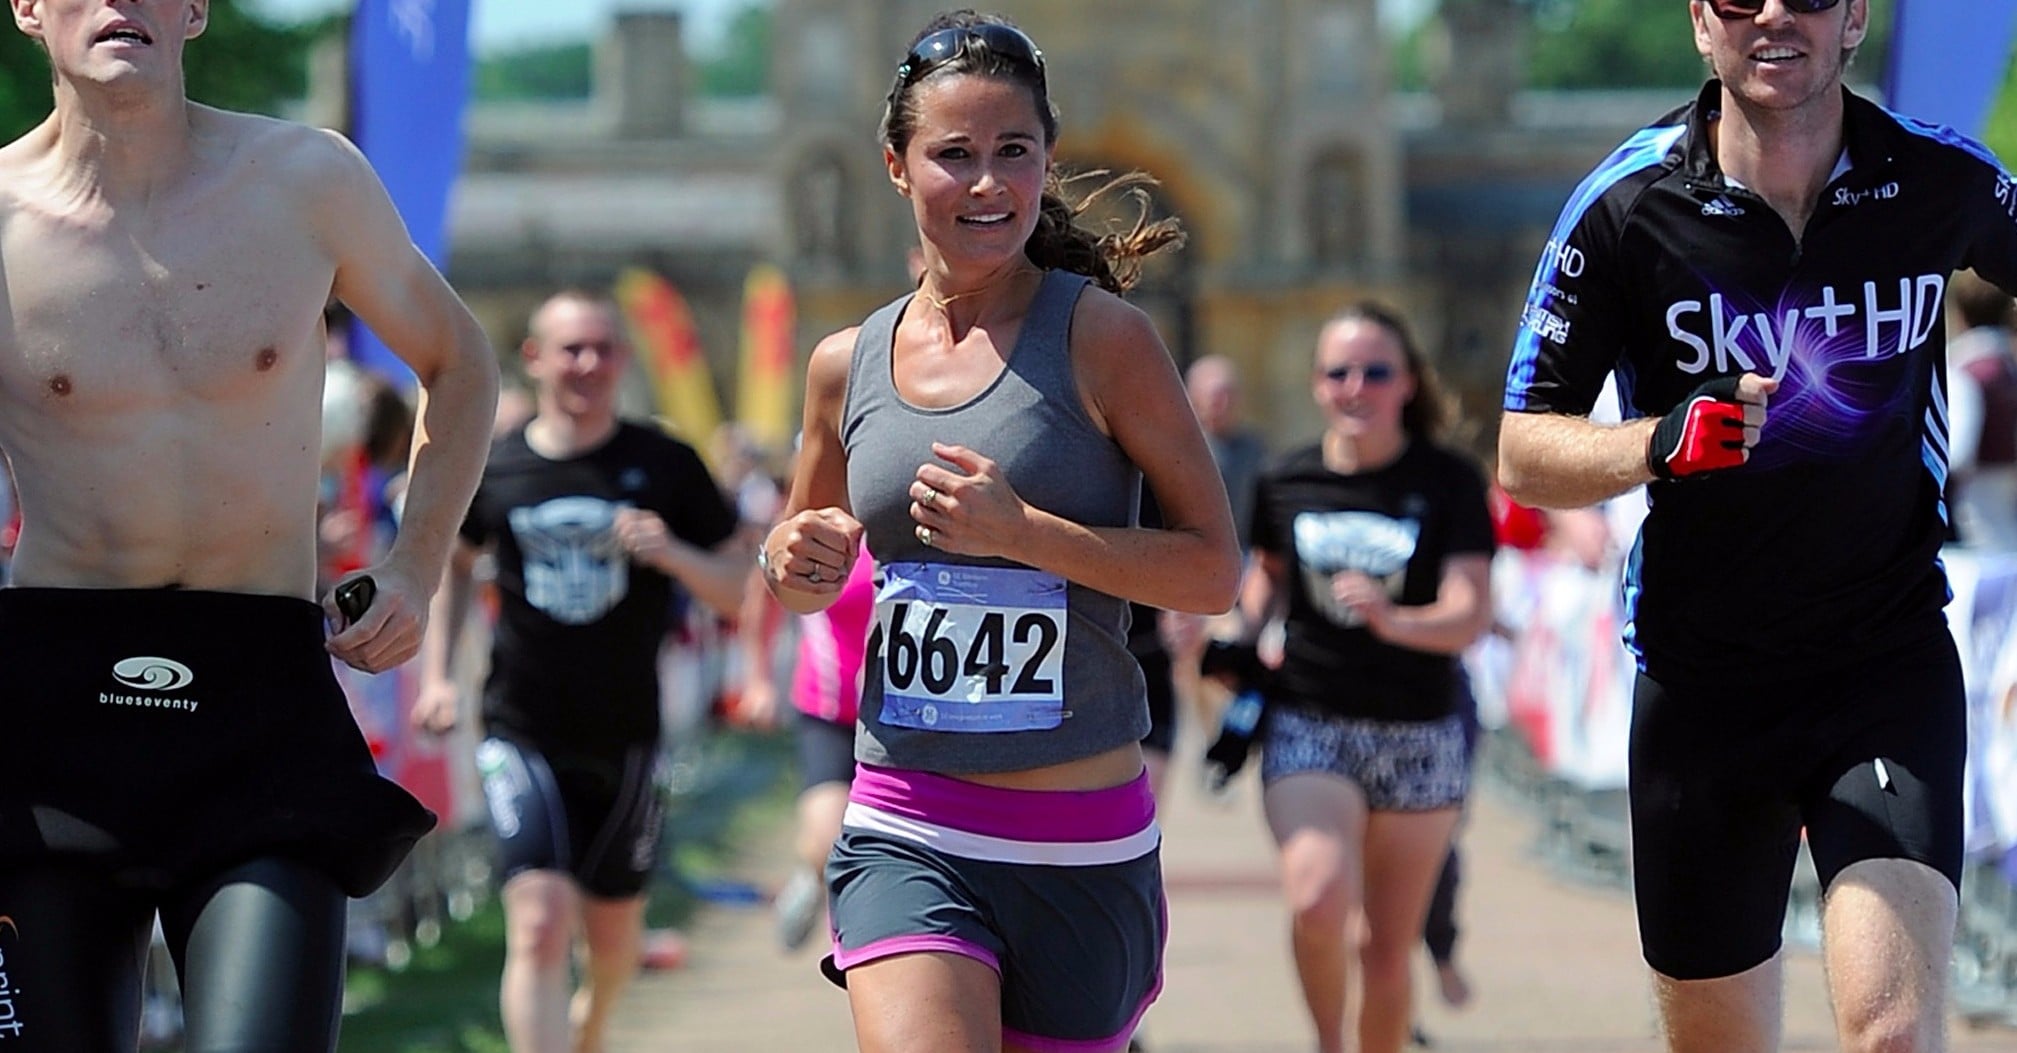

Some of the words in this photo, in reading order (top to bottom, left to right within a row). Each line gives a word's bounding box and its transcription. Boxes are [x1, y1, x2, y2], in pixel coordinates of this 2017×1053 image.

[887, 602, 1059, 695] 6642
[99, 691, 199, 713] blueseventy
[0, 947, 24, 1039] rint
